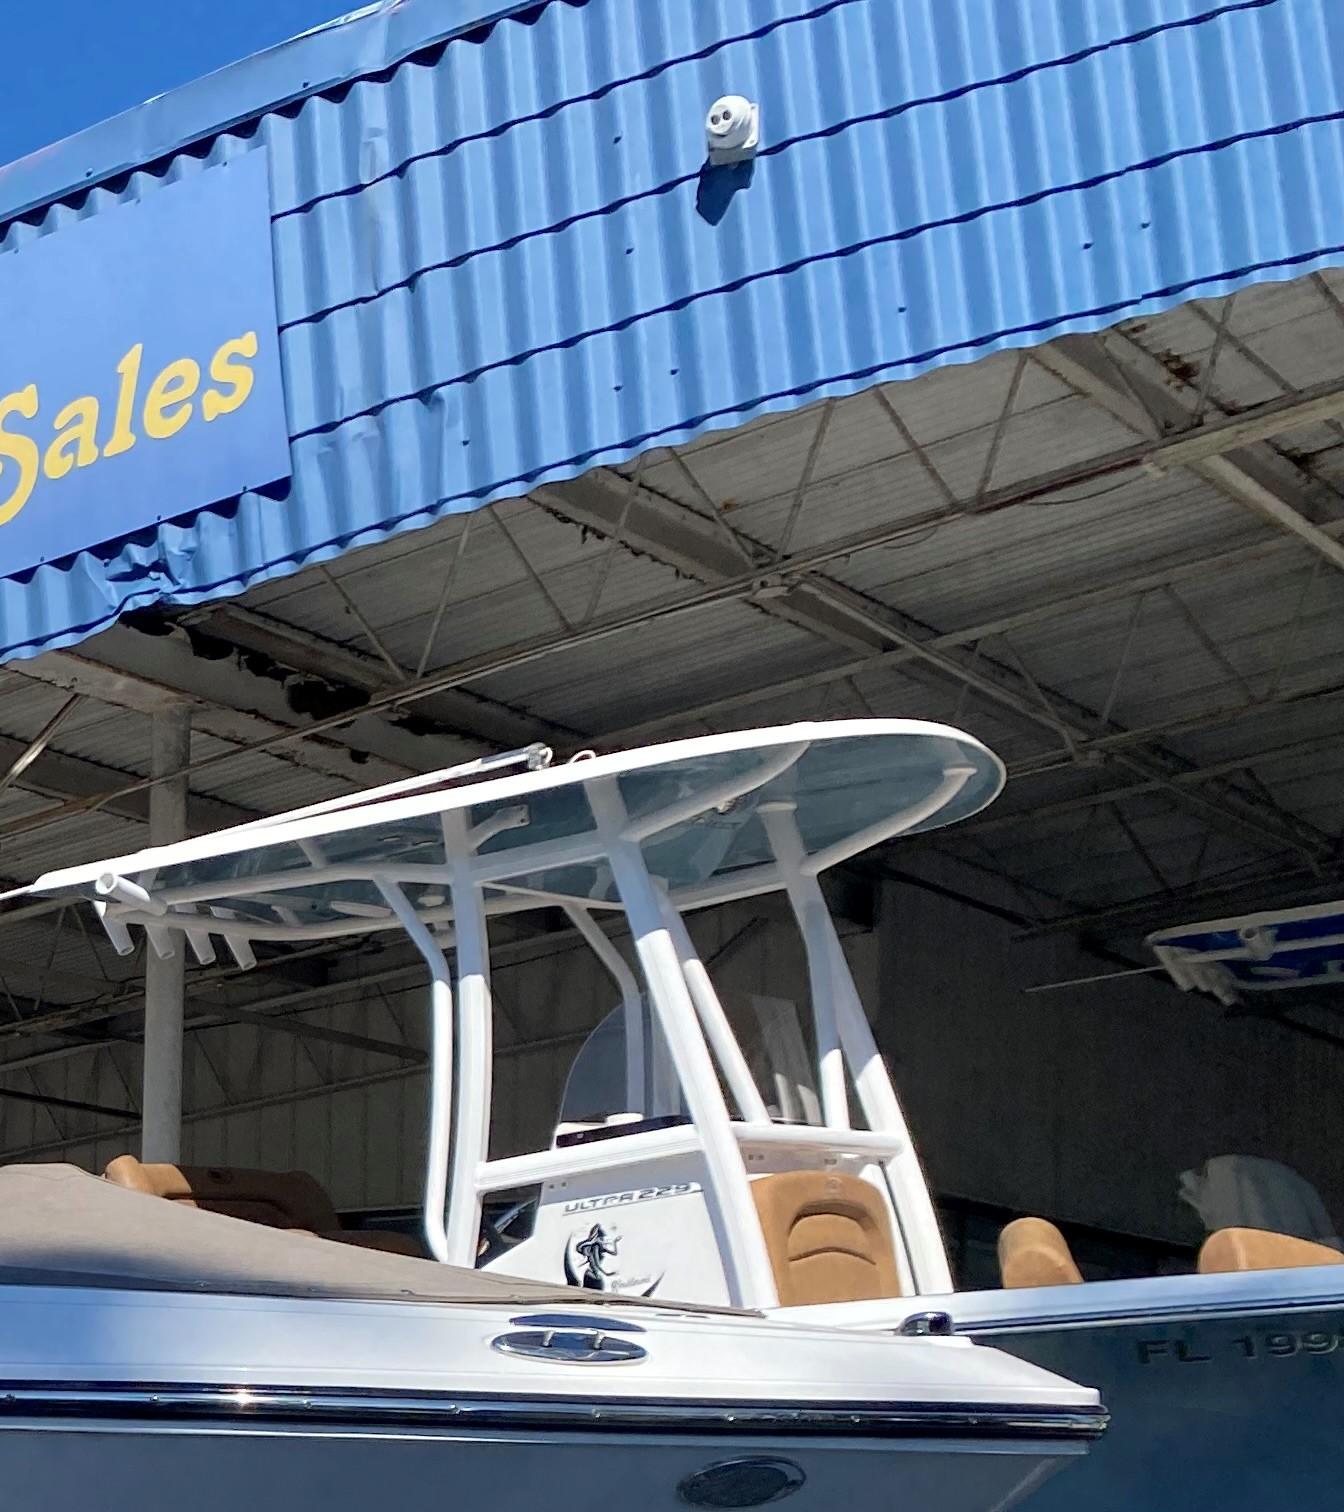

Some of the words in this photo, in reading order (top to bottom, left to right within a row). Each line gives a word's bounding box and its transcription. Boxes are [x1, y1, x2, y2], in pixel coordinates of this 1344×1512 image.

[564, 1192, 634, 1213] ULTRA
[638, 1182, 692, 1200] 229
[1136, 1339, 1212, 1365] FL
